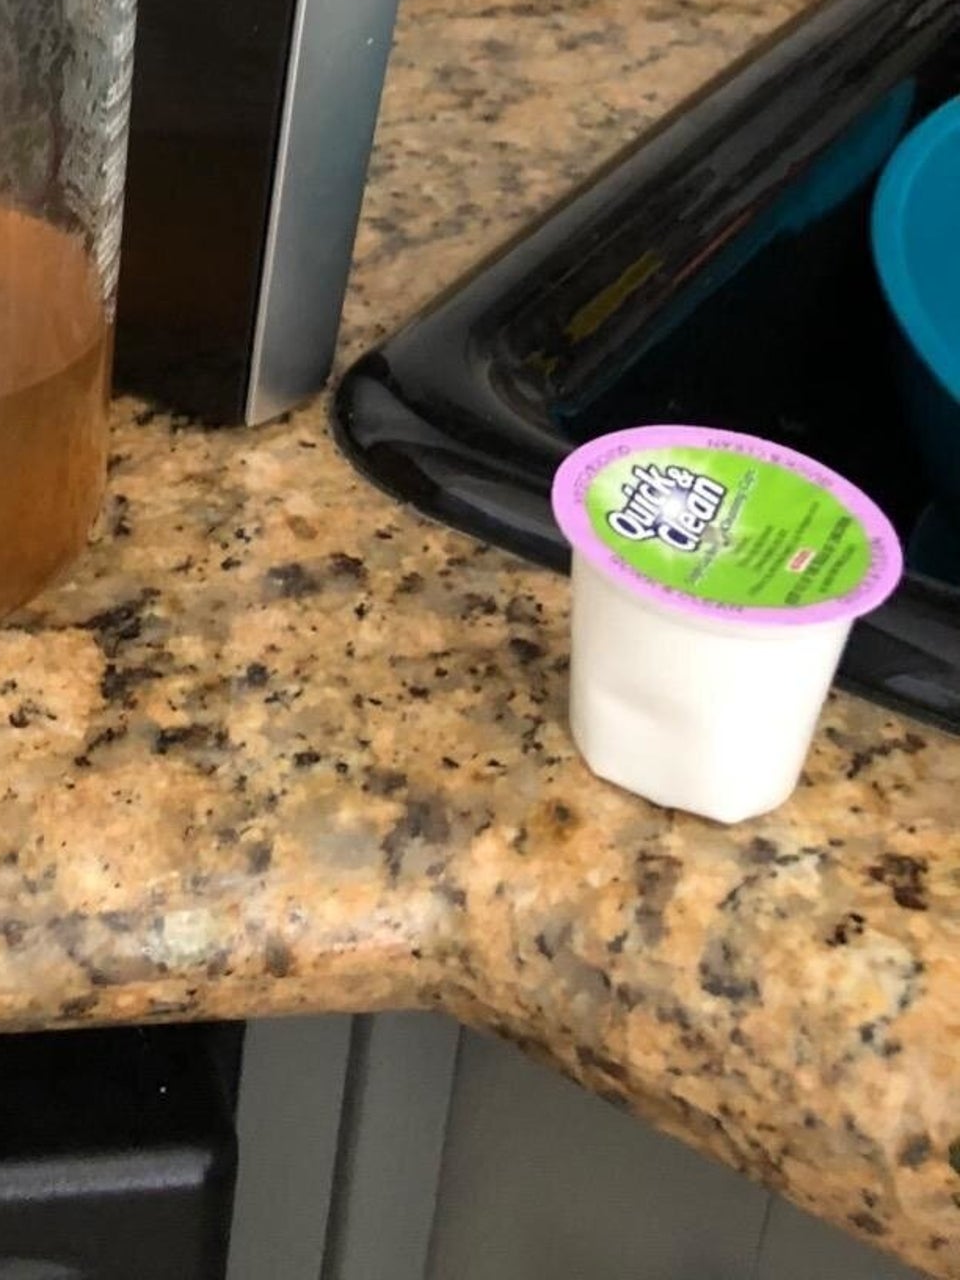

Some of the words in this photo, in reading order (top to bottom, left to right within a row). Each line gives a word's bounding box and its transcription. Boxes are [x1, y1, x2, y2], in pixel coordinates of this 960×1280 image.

[606, 464, 676, 541] Quick
[665, 465, 696, 490] &
[657, 475, 727, 551] Clean
